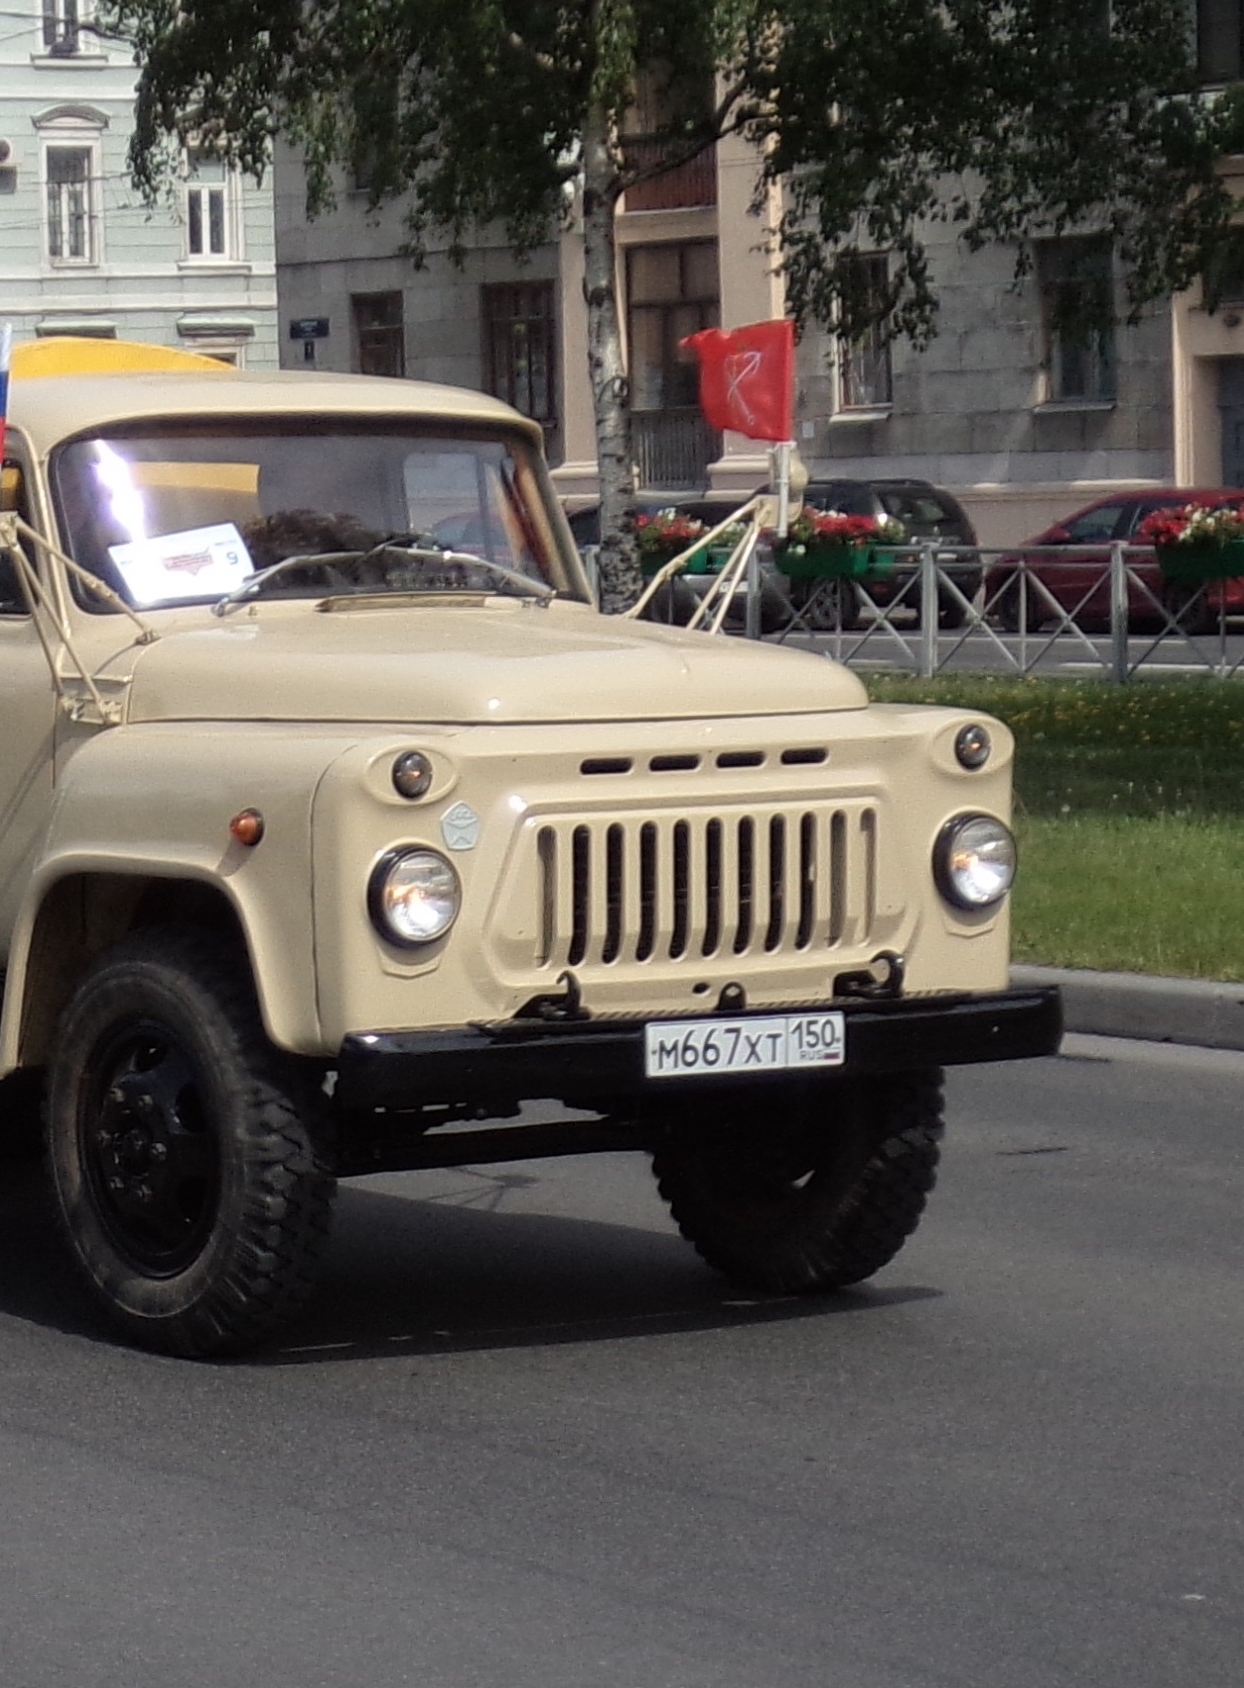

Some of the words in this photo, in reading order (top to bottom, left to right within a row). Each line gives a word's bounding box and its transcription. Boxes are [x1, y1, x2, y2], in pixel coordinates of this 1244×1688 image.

[657, 1026, 783, 1069] М667ХТ
[790, 1018, 836, 1049] 150
[799, 1050, 824, 1061] RUS
